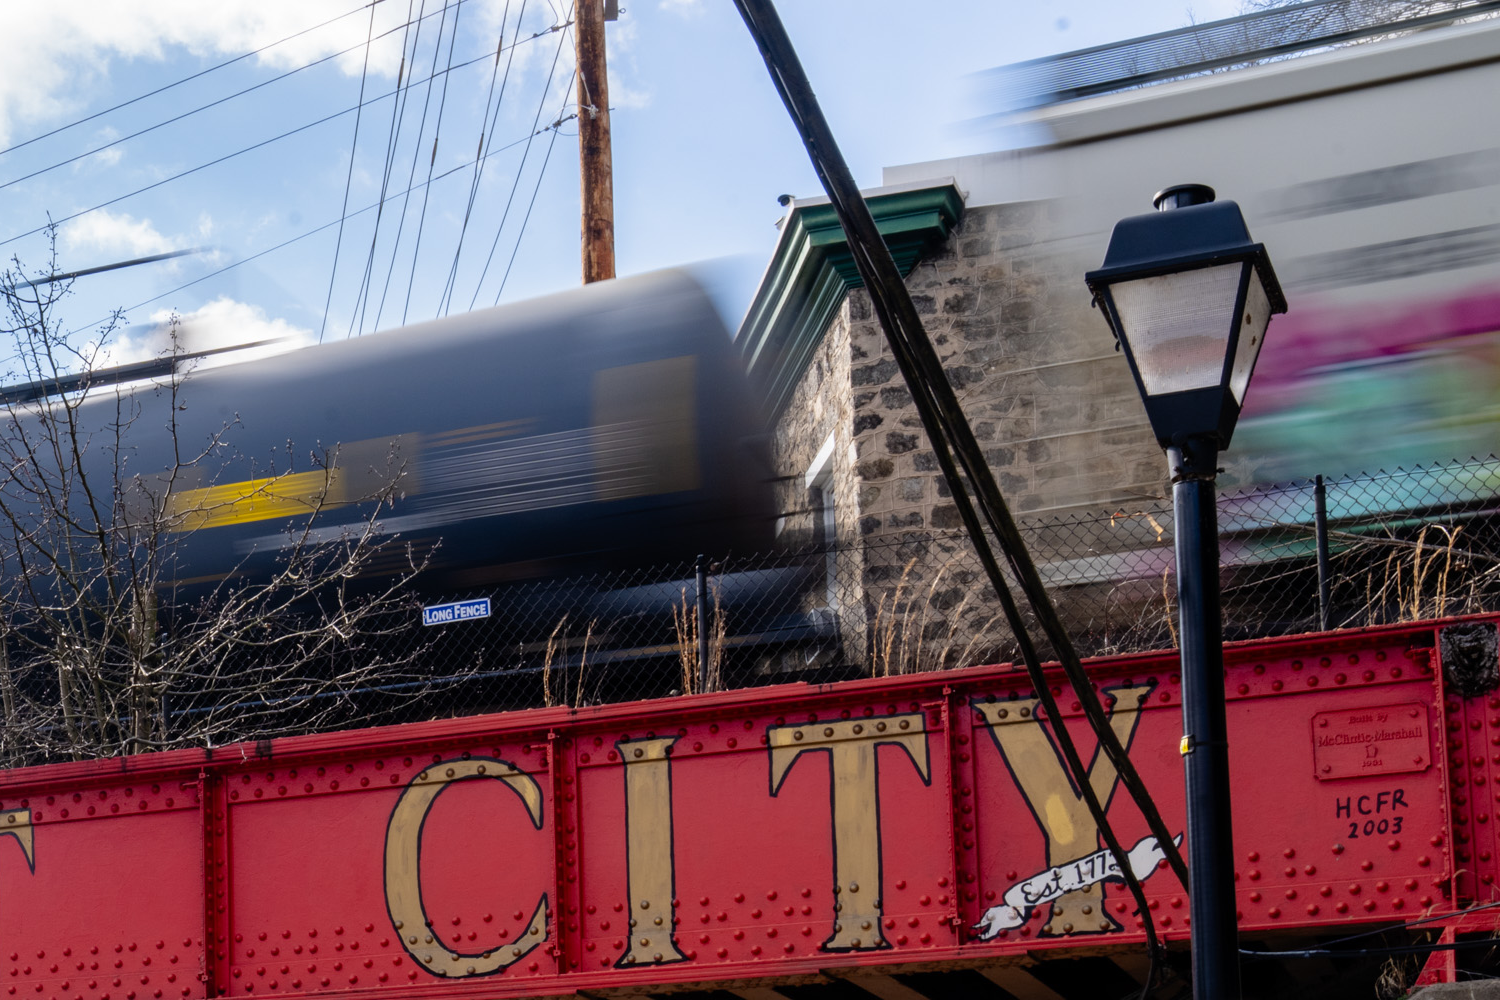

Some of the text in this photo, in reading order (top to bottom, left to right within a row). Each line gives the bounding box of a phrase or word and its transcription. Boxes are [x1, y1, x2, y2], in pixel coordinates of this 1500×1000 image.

[426, 604, 487, 623] LONG FENCE
[1348, 714, 1374, 724] Built
[1335, 788, 1409, 819] HCFR
[383, 680, 1156, 978] CITY
[1347, 816, 1404, 839] 2003
